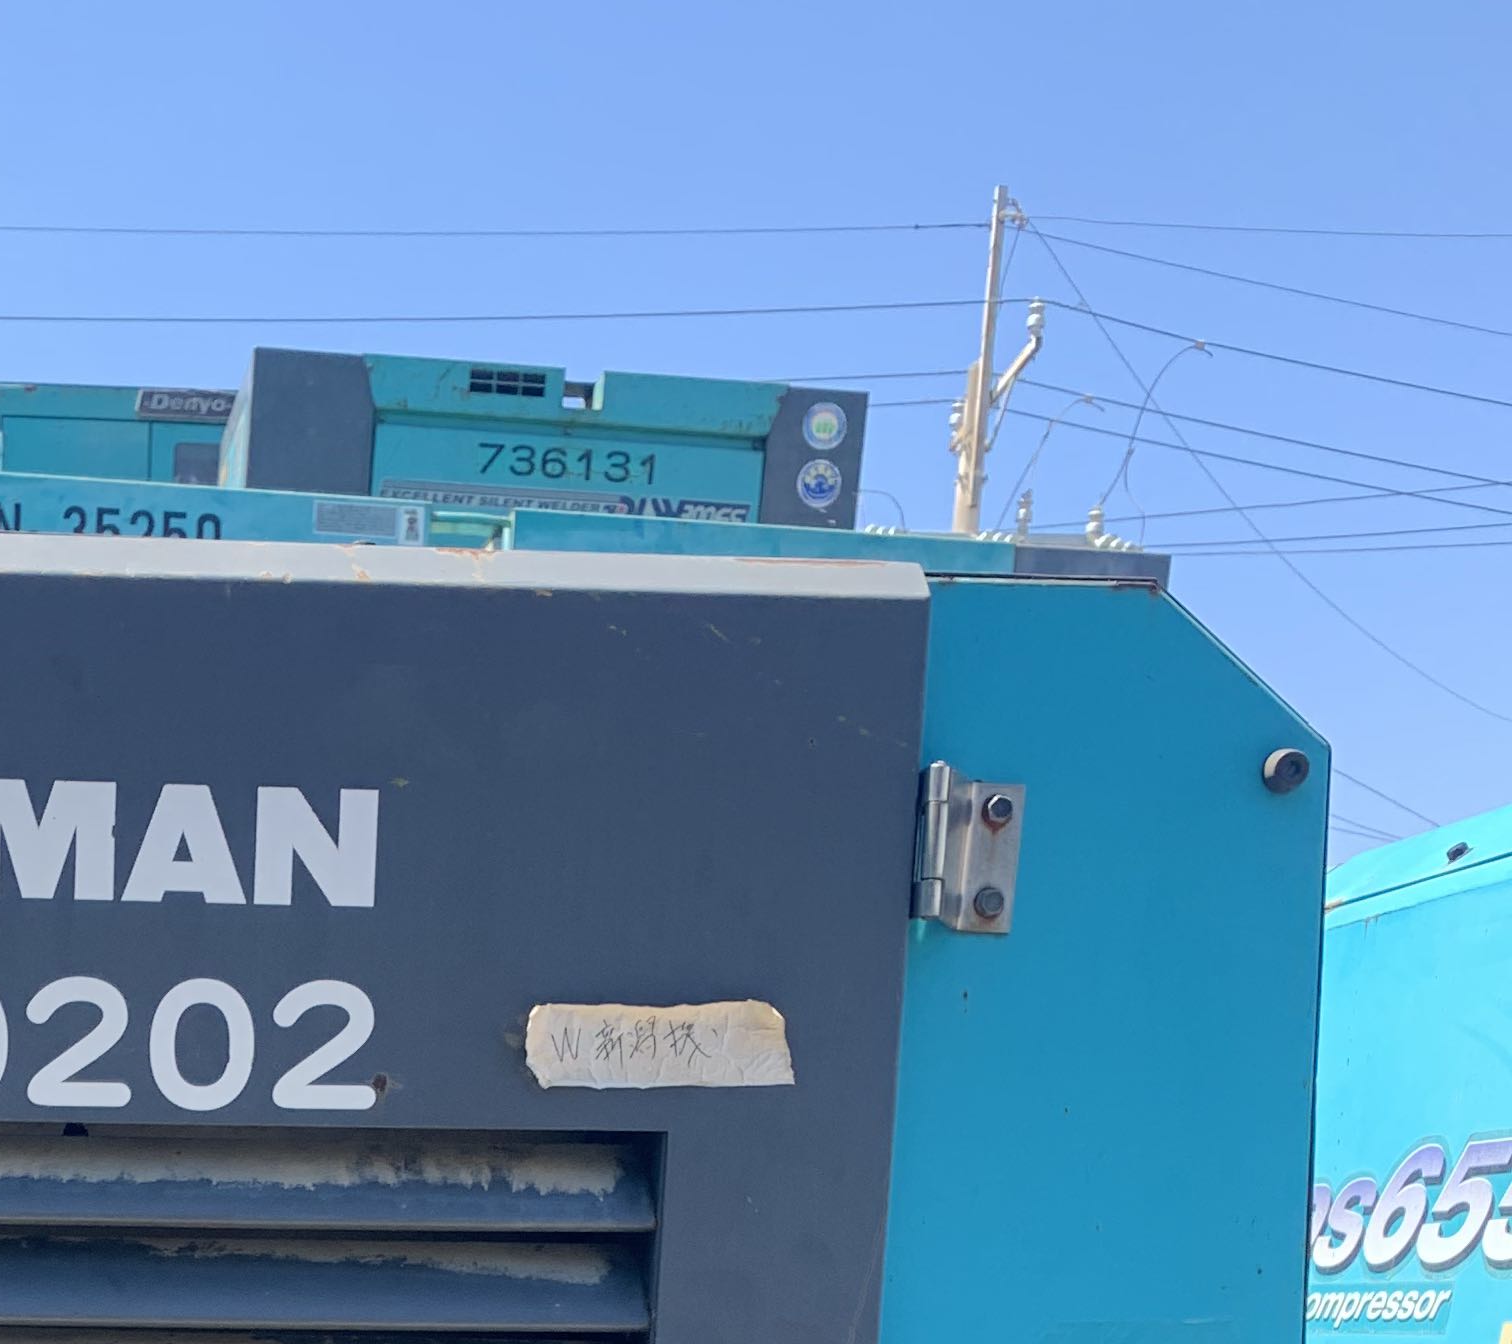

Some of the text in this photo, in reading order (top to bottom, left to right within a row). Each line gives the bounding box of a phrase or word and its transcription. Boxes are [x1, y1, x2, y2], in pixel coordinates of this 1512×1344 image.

[150, 393, 226, 415] Denyo
[477, 442, 657, 486] 736131
[1312, 1134, 1512, 1275] S65
